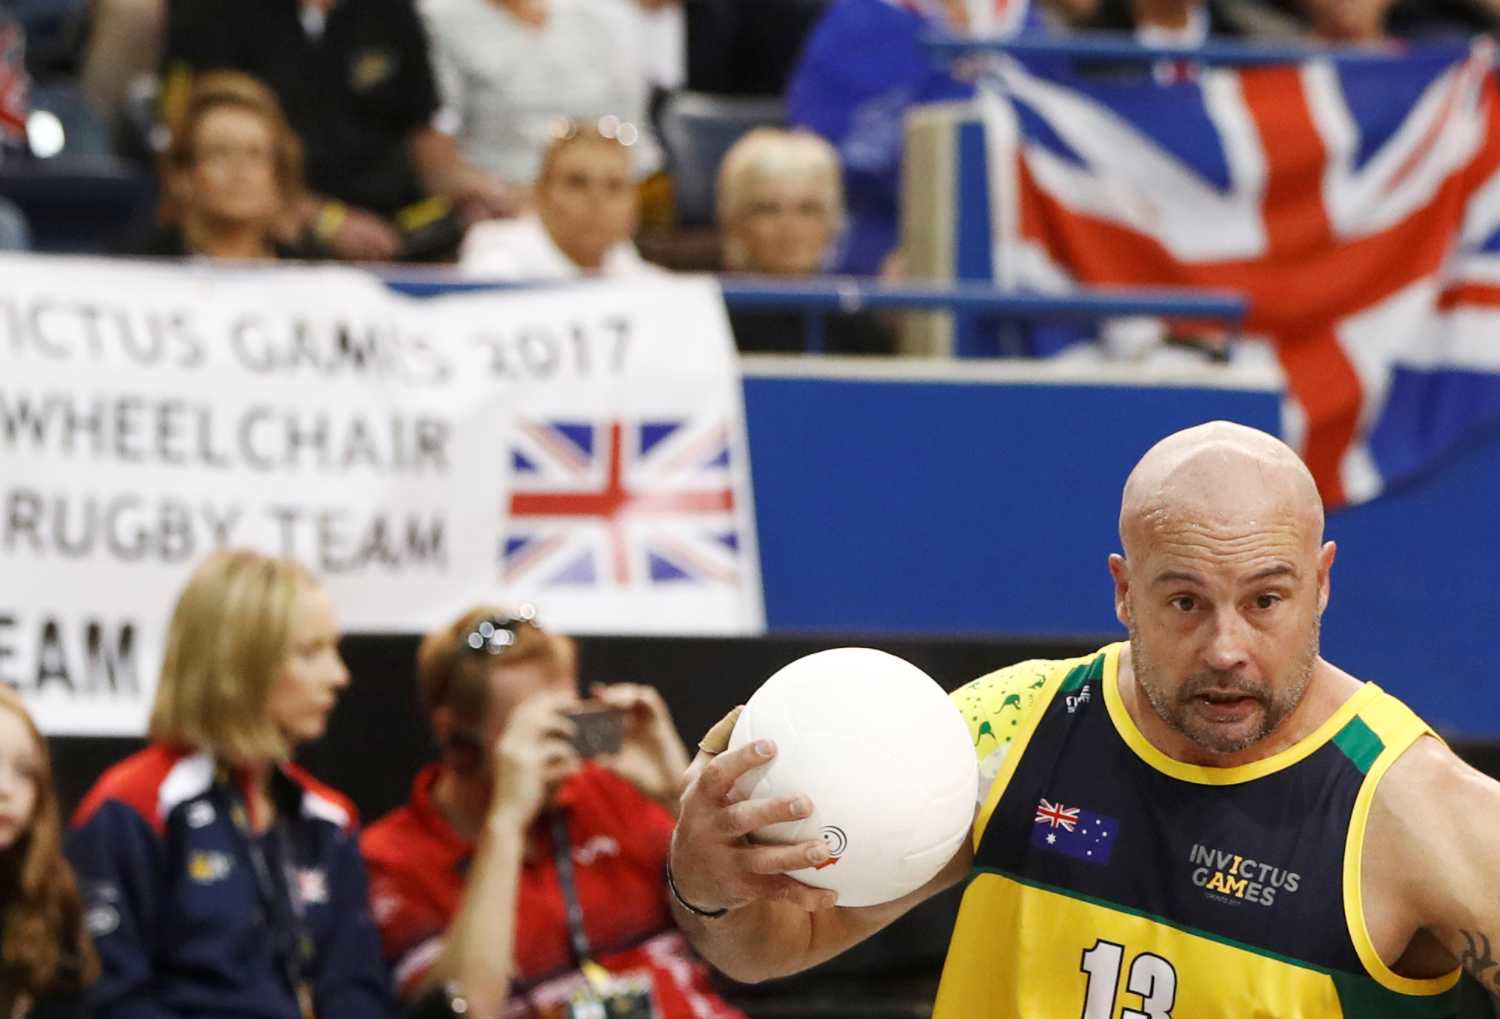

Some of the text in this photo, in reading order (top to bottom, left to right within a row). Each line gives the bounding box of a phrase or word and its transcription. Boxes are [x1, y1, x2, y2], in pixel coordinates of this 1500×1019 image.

[0, 295, 207, 370] ICTUS
[0, 391, 452, 473] WHEELCHAIR
[4, 486, 450, 576] RUGBY TEAM
[1189, 843, 1301, 893] INVICTUS
[1191, 867, 1277, 907] GAMES
